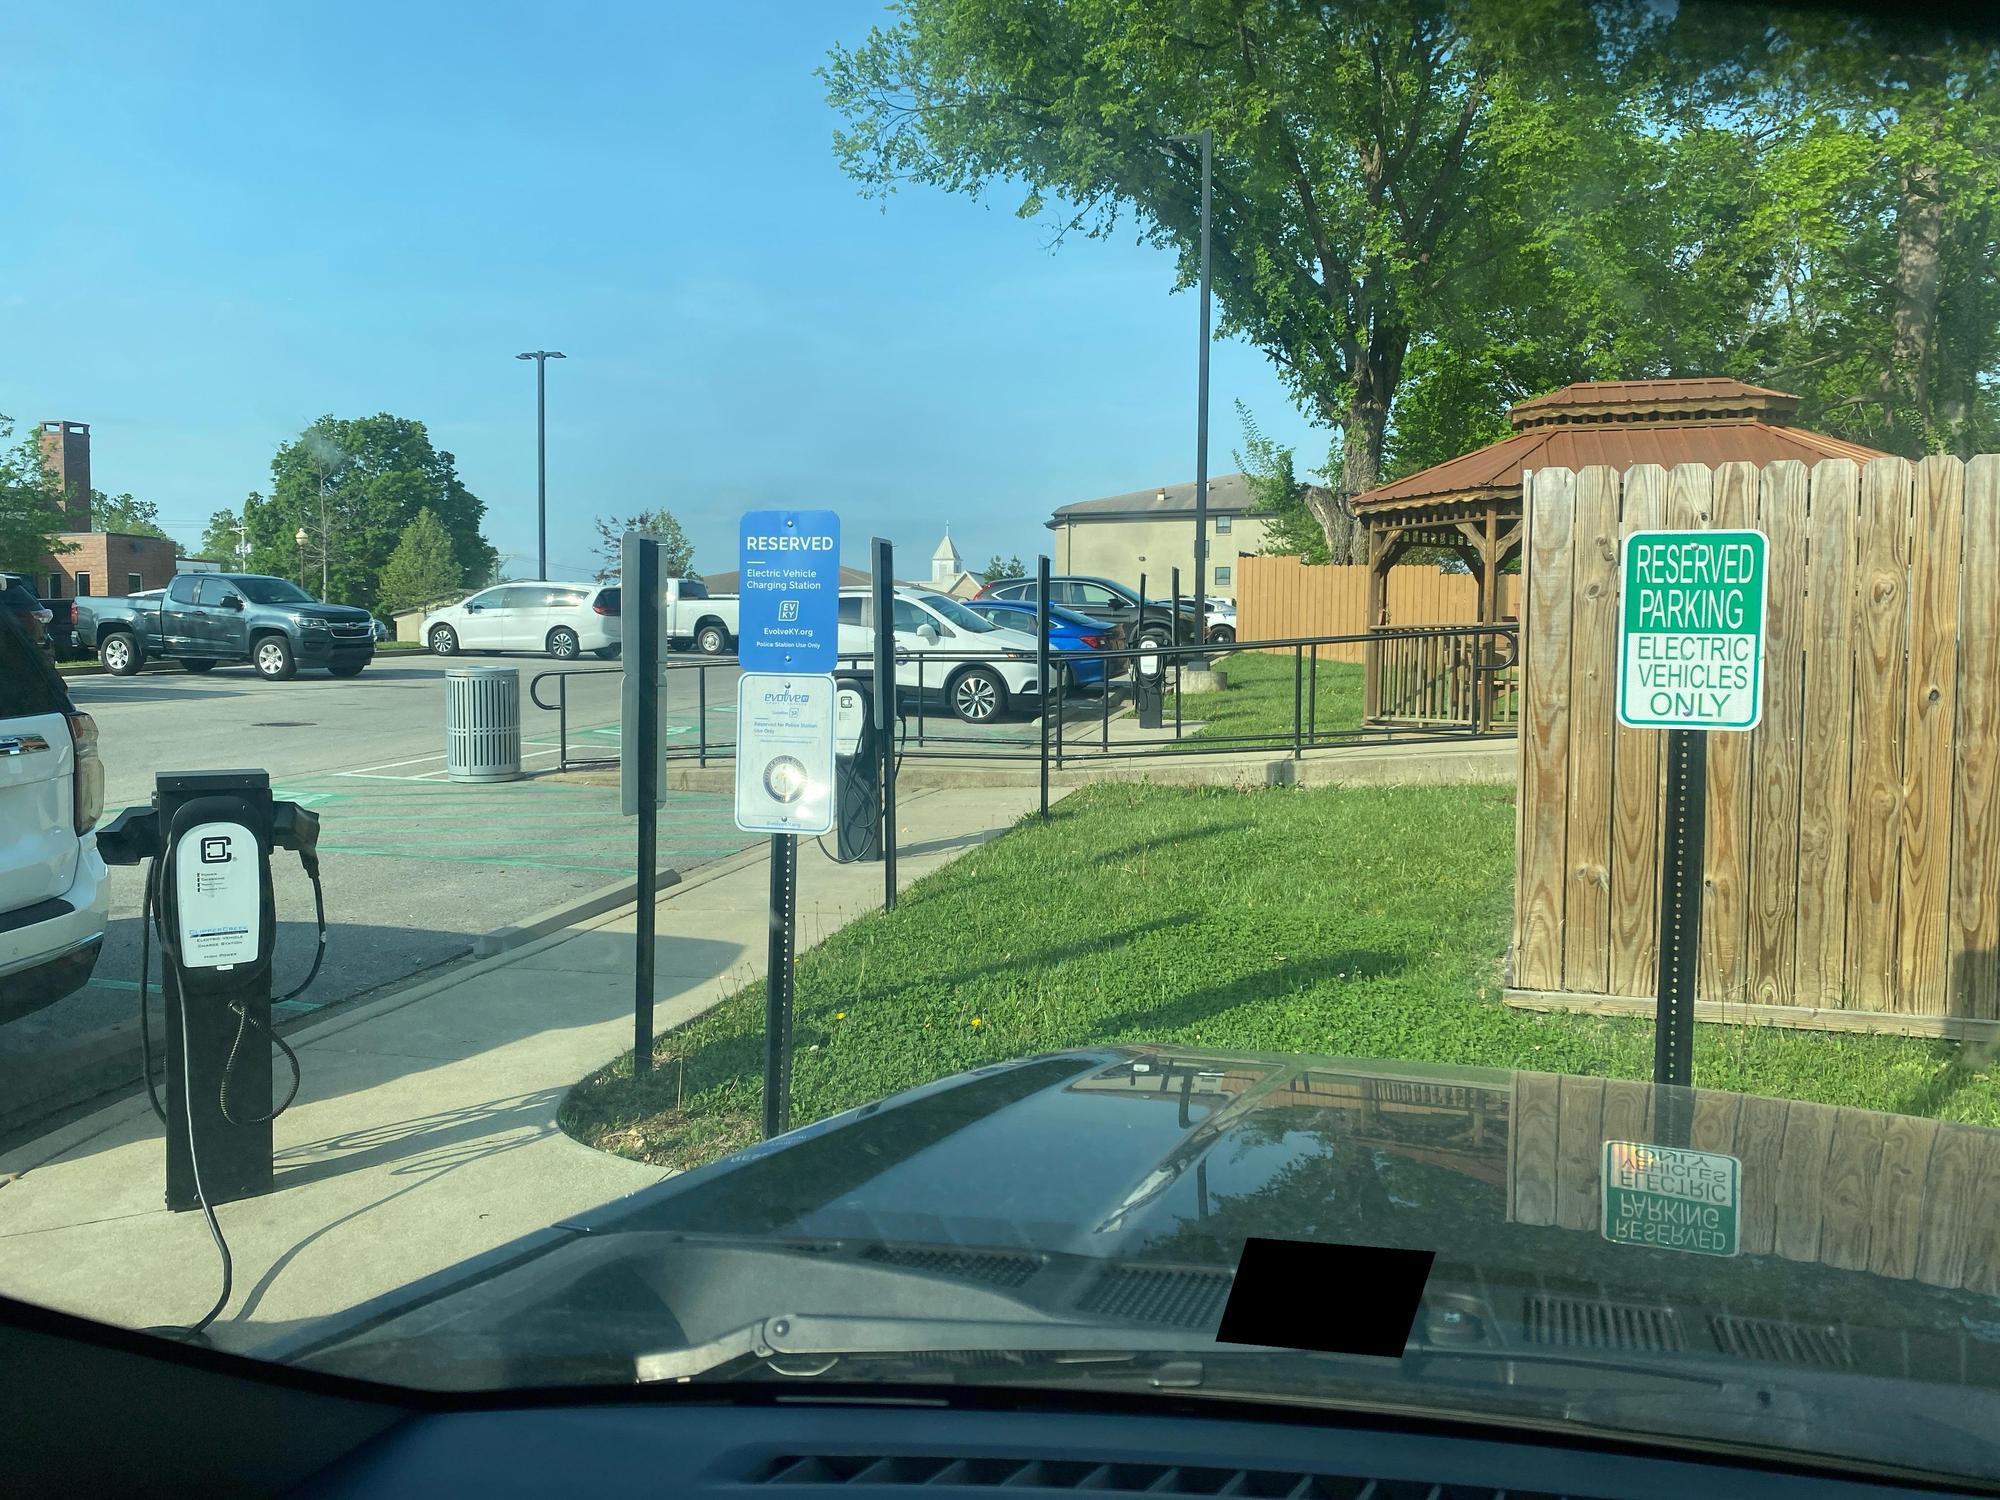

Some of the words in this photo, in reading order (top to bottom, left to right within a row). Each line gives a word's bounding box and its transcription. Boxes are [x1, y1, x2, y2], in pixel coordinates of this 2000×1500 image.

[746, 536, 834, 551] RESERVED
[1636, 544, 1754, 584] RESERVED
[747, 568, 781, 578] Electric
[783, 569, 817, 578] Vehicle
[746, 580, 787, 591] Charging
[789, 581, 821, 590] Station
[783, 603, 796, 611] EV
[1639, 588, 1744, 629] PARKING
[782, 611, 795, 619] KY
[763, 627, 814, 637] EvolveKY.org
[807, 642, 821, 650] Only
[1637, 636, 1749, 661] ELECTRIC
[1638, 663, 1748, 689] VEHICLES
[1650, 692, 1732, 717] ONLY
